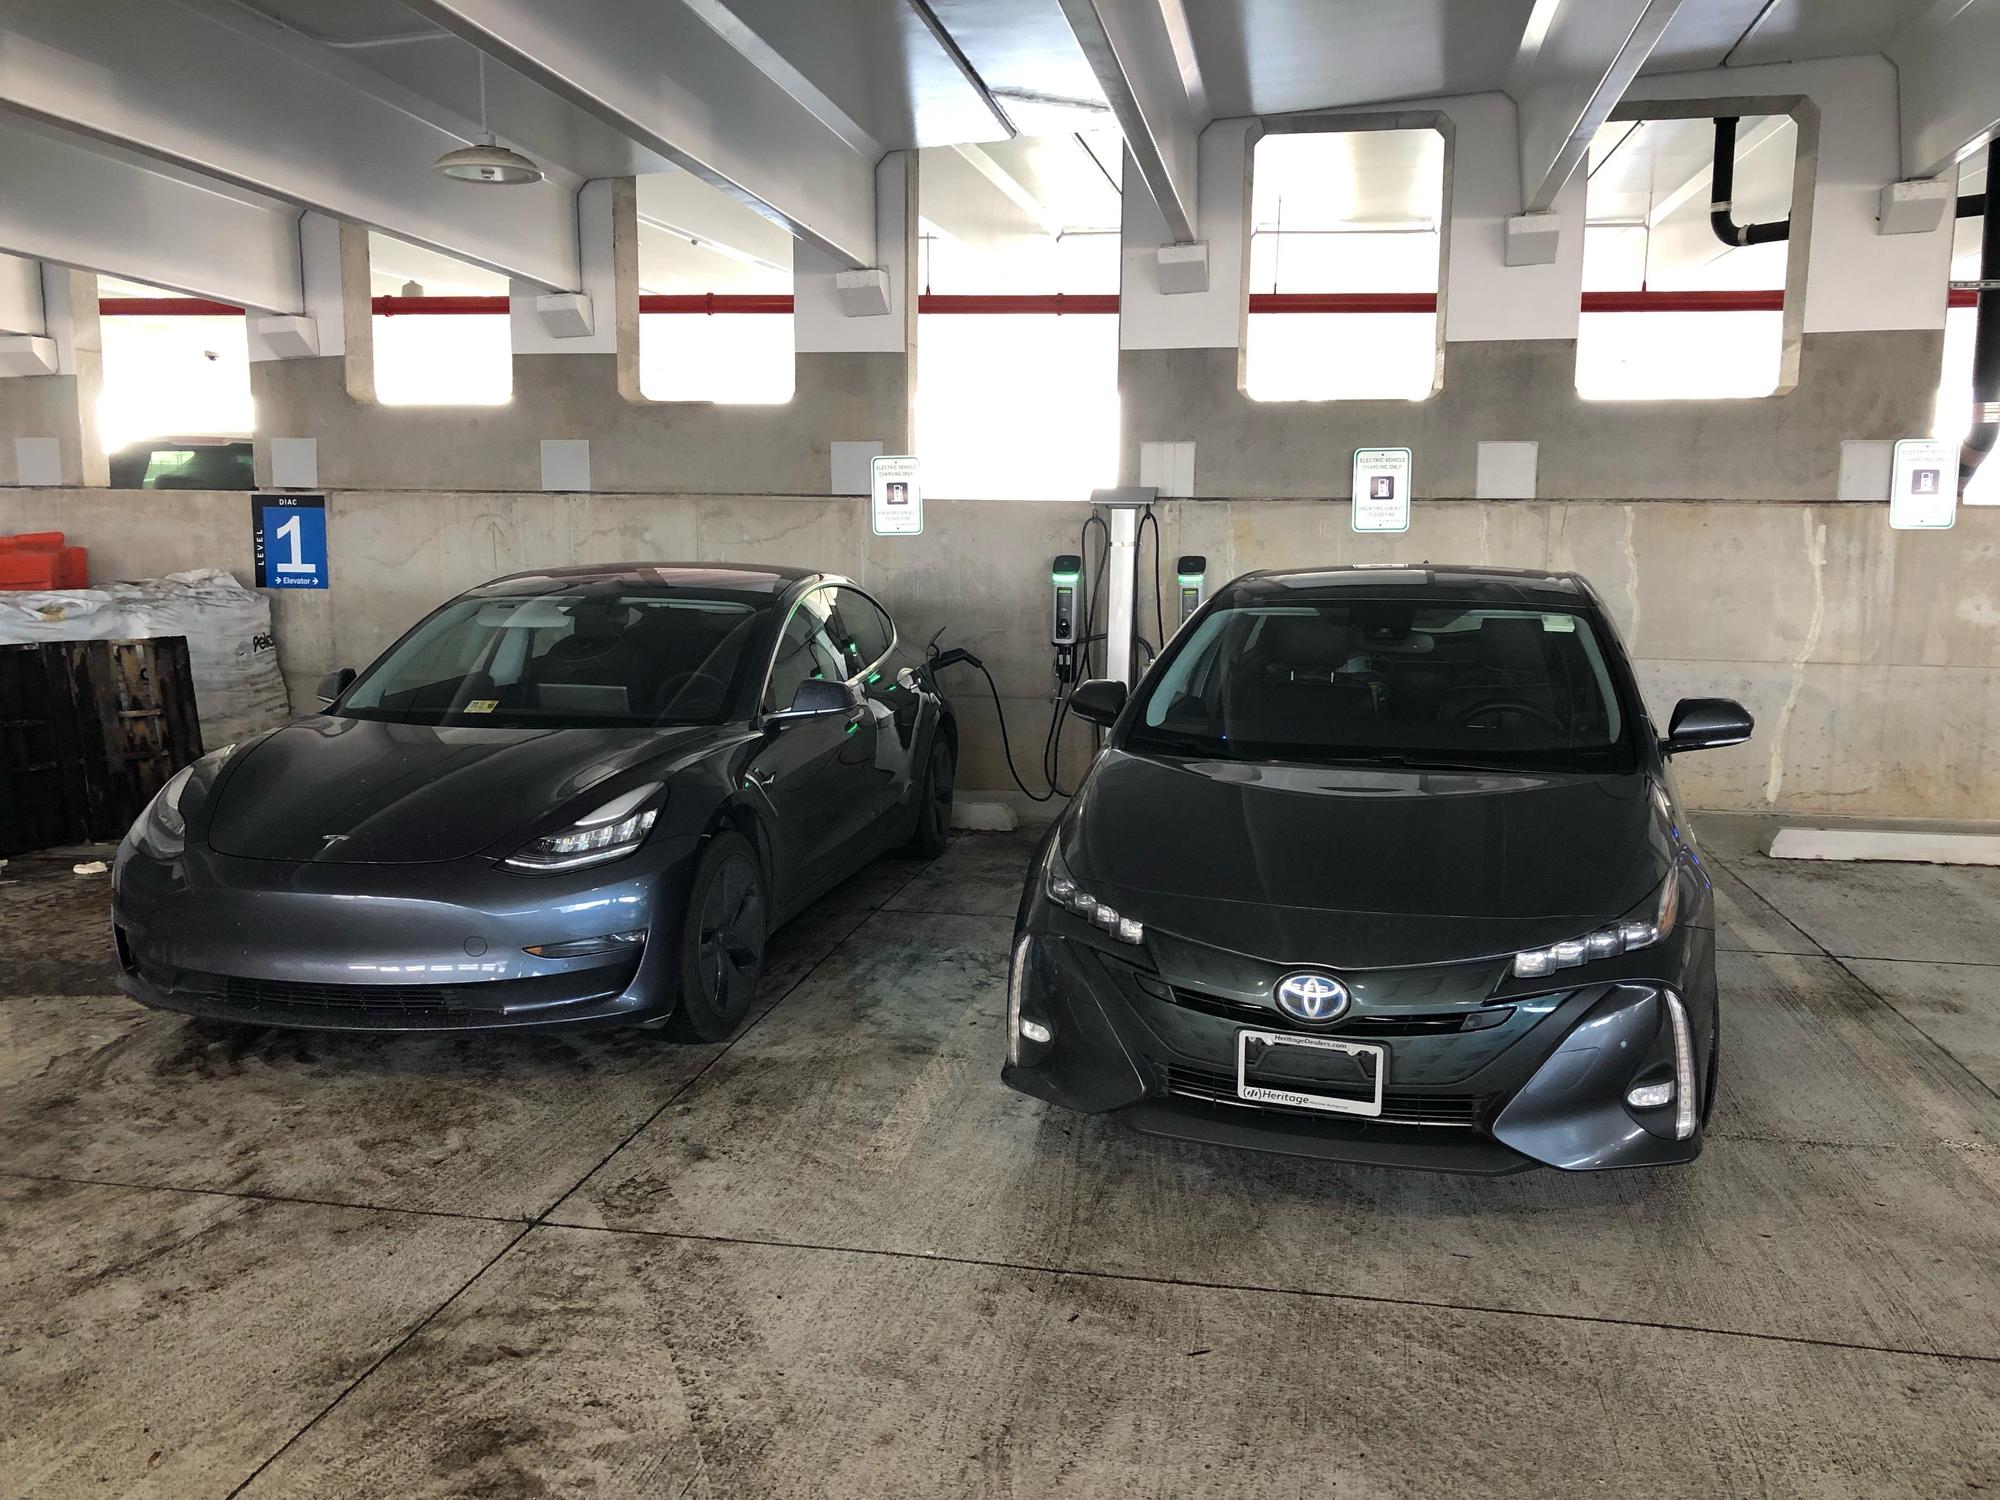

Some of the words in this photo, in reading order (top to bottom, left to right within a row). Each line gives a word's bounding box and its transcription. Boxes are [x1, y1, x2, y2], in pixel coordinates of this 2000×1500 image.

[279, 498, 298, 506] DIAC
[256, 529, 265, 566] LEVEL
[276, 515, 317, 573] 1
[283, 577, 311, 585] Elevator
[1274, 1034, 1348, 1050] HeritageDealers.com
[1262, 1089, 1310, 1105] Heritage
